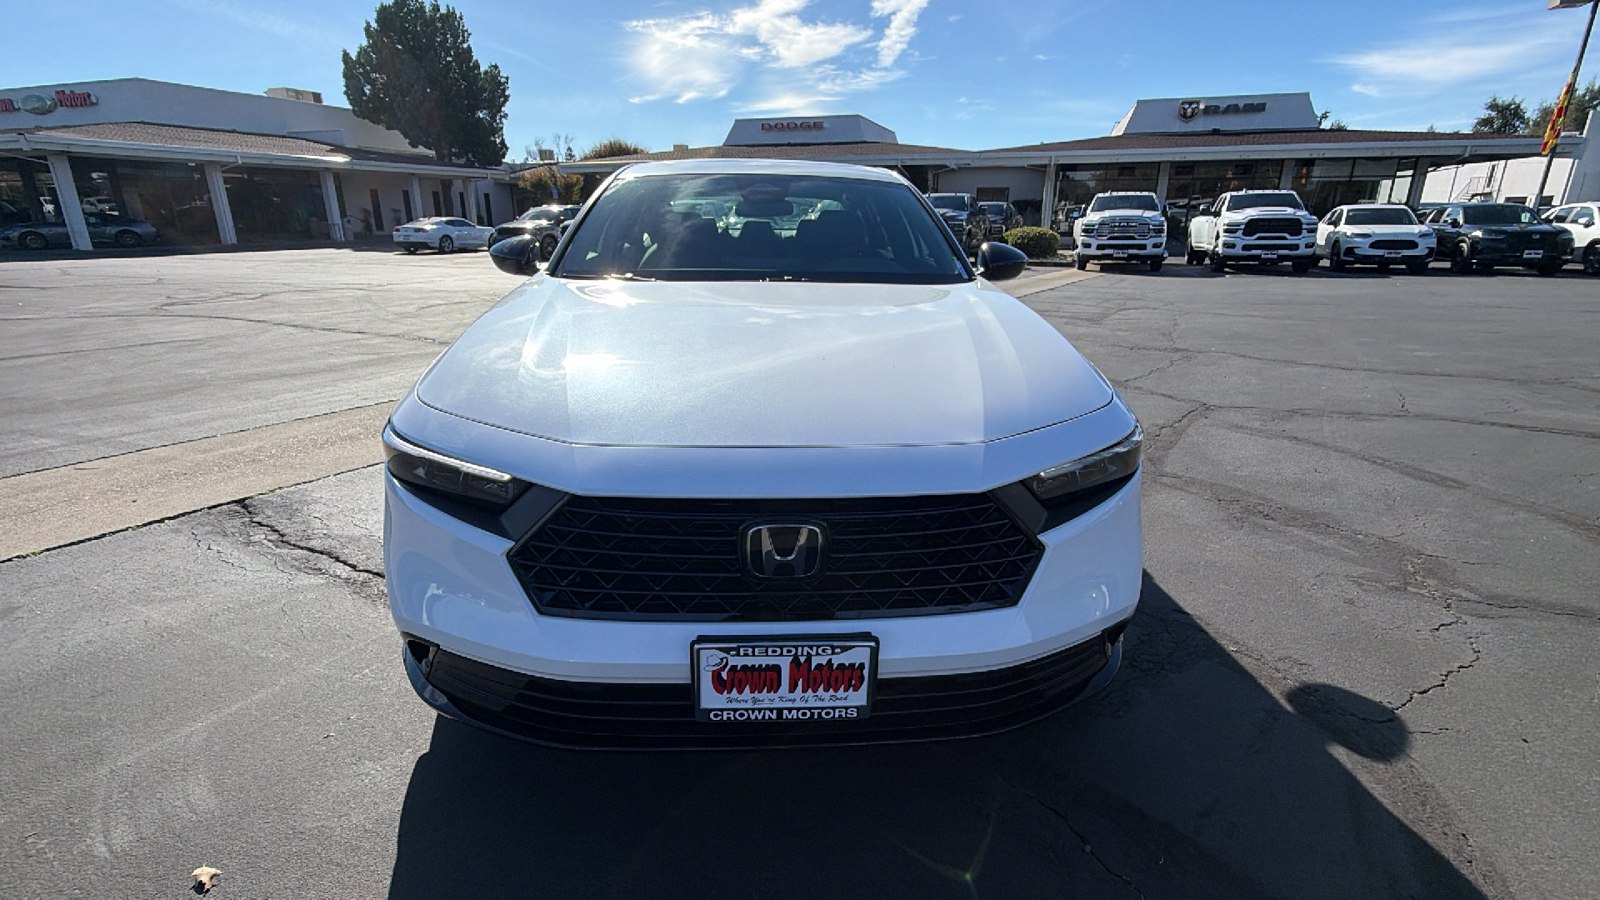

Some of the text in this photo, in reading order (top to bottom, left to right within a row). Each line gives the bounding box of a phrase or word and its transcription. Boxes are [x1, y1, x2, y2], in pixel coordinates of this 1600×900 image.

[54, 90, 91, 107] Motors
[1203, 102, 1267, 114] RAM
[761, 121, 824, 131] DODGE
[740, 646, 832, 656] REDDING
[711, 655, 865, 695] Crown Motors
[751, 696, 775, 706] You're
[777, 695, 797, 704] King
[800, 695, 810, 703] Of
[812, 694, 825, 702] The
[828, 694, 849, 702] Road
[709, 708, 858, 720] CROWN MOTORS
